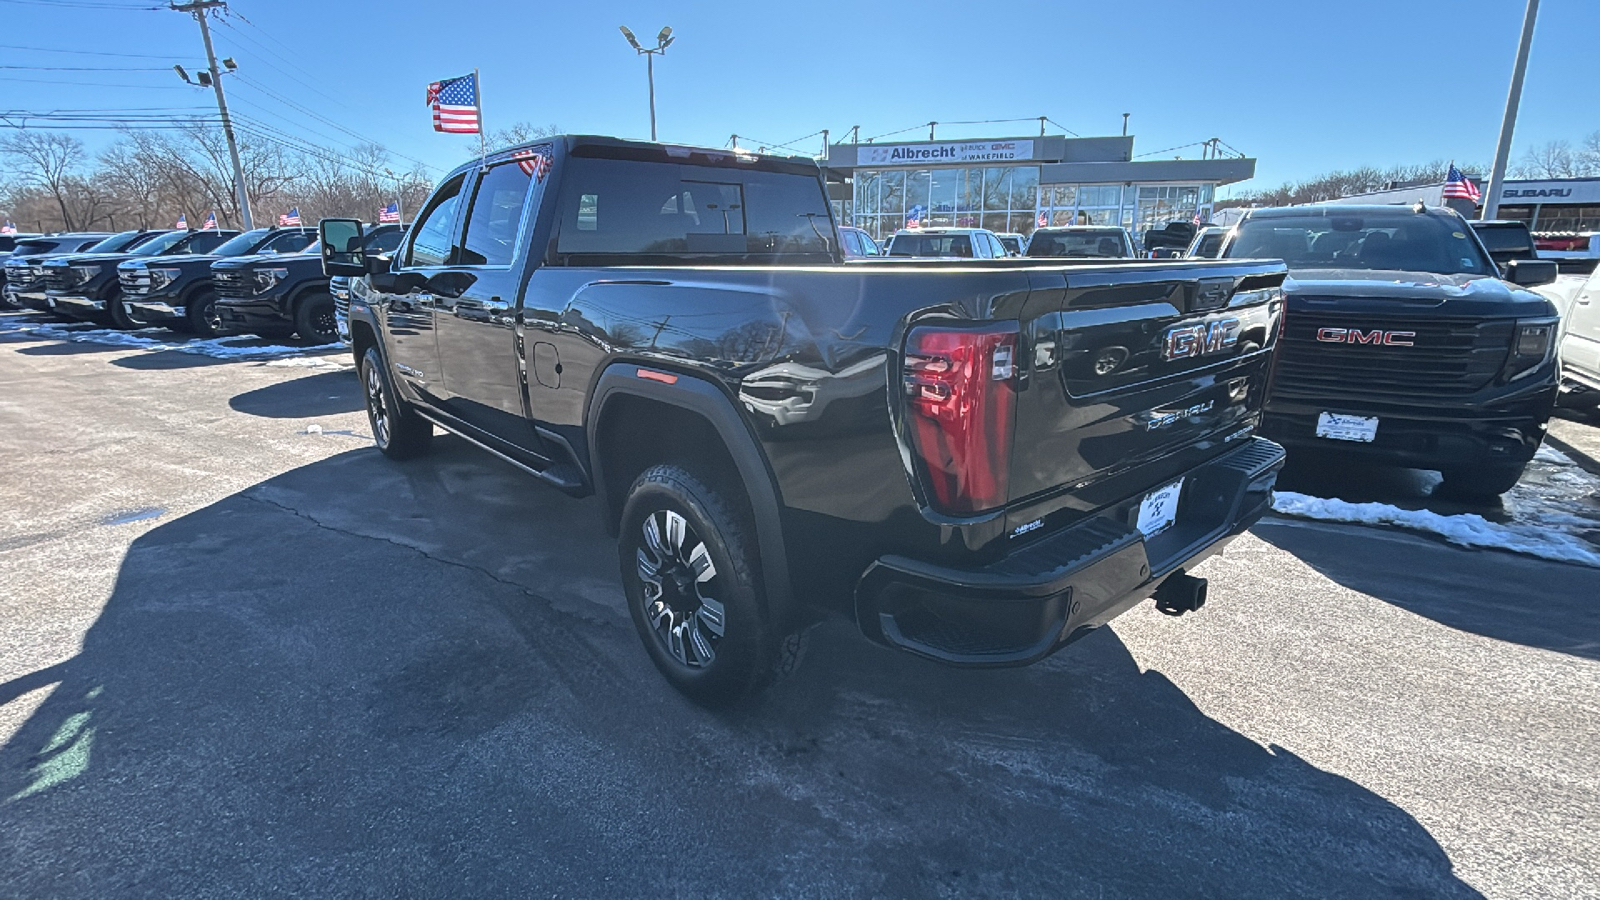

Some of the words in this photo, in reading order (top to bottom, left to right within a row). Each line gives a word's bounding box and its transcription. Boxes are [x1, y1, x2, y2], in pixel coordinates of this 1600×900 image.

[891, 146, 956, 160] Albrecht
[991, 143, 1016, 151] GMC
[969, 152, 1015, 160] WAKEFIELD
[1502, 188, 1572, 198] SUBARU
[1164, 318, 1239, 361] GMC
[1316, 327, 1416, 346] GMC
